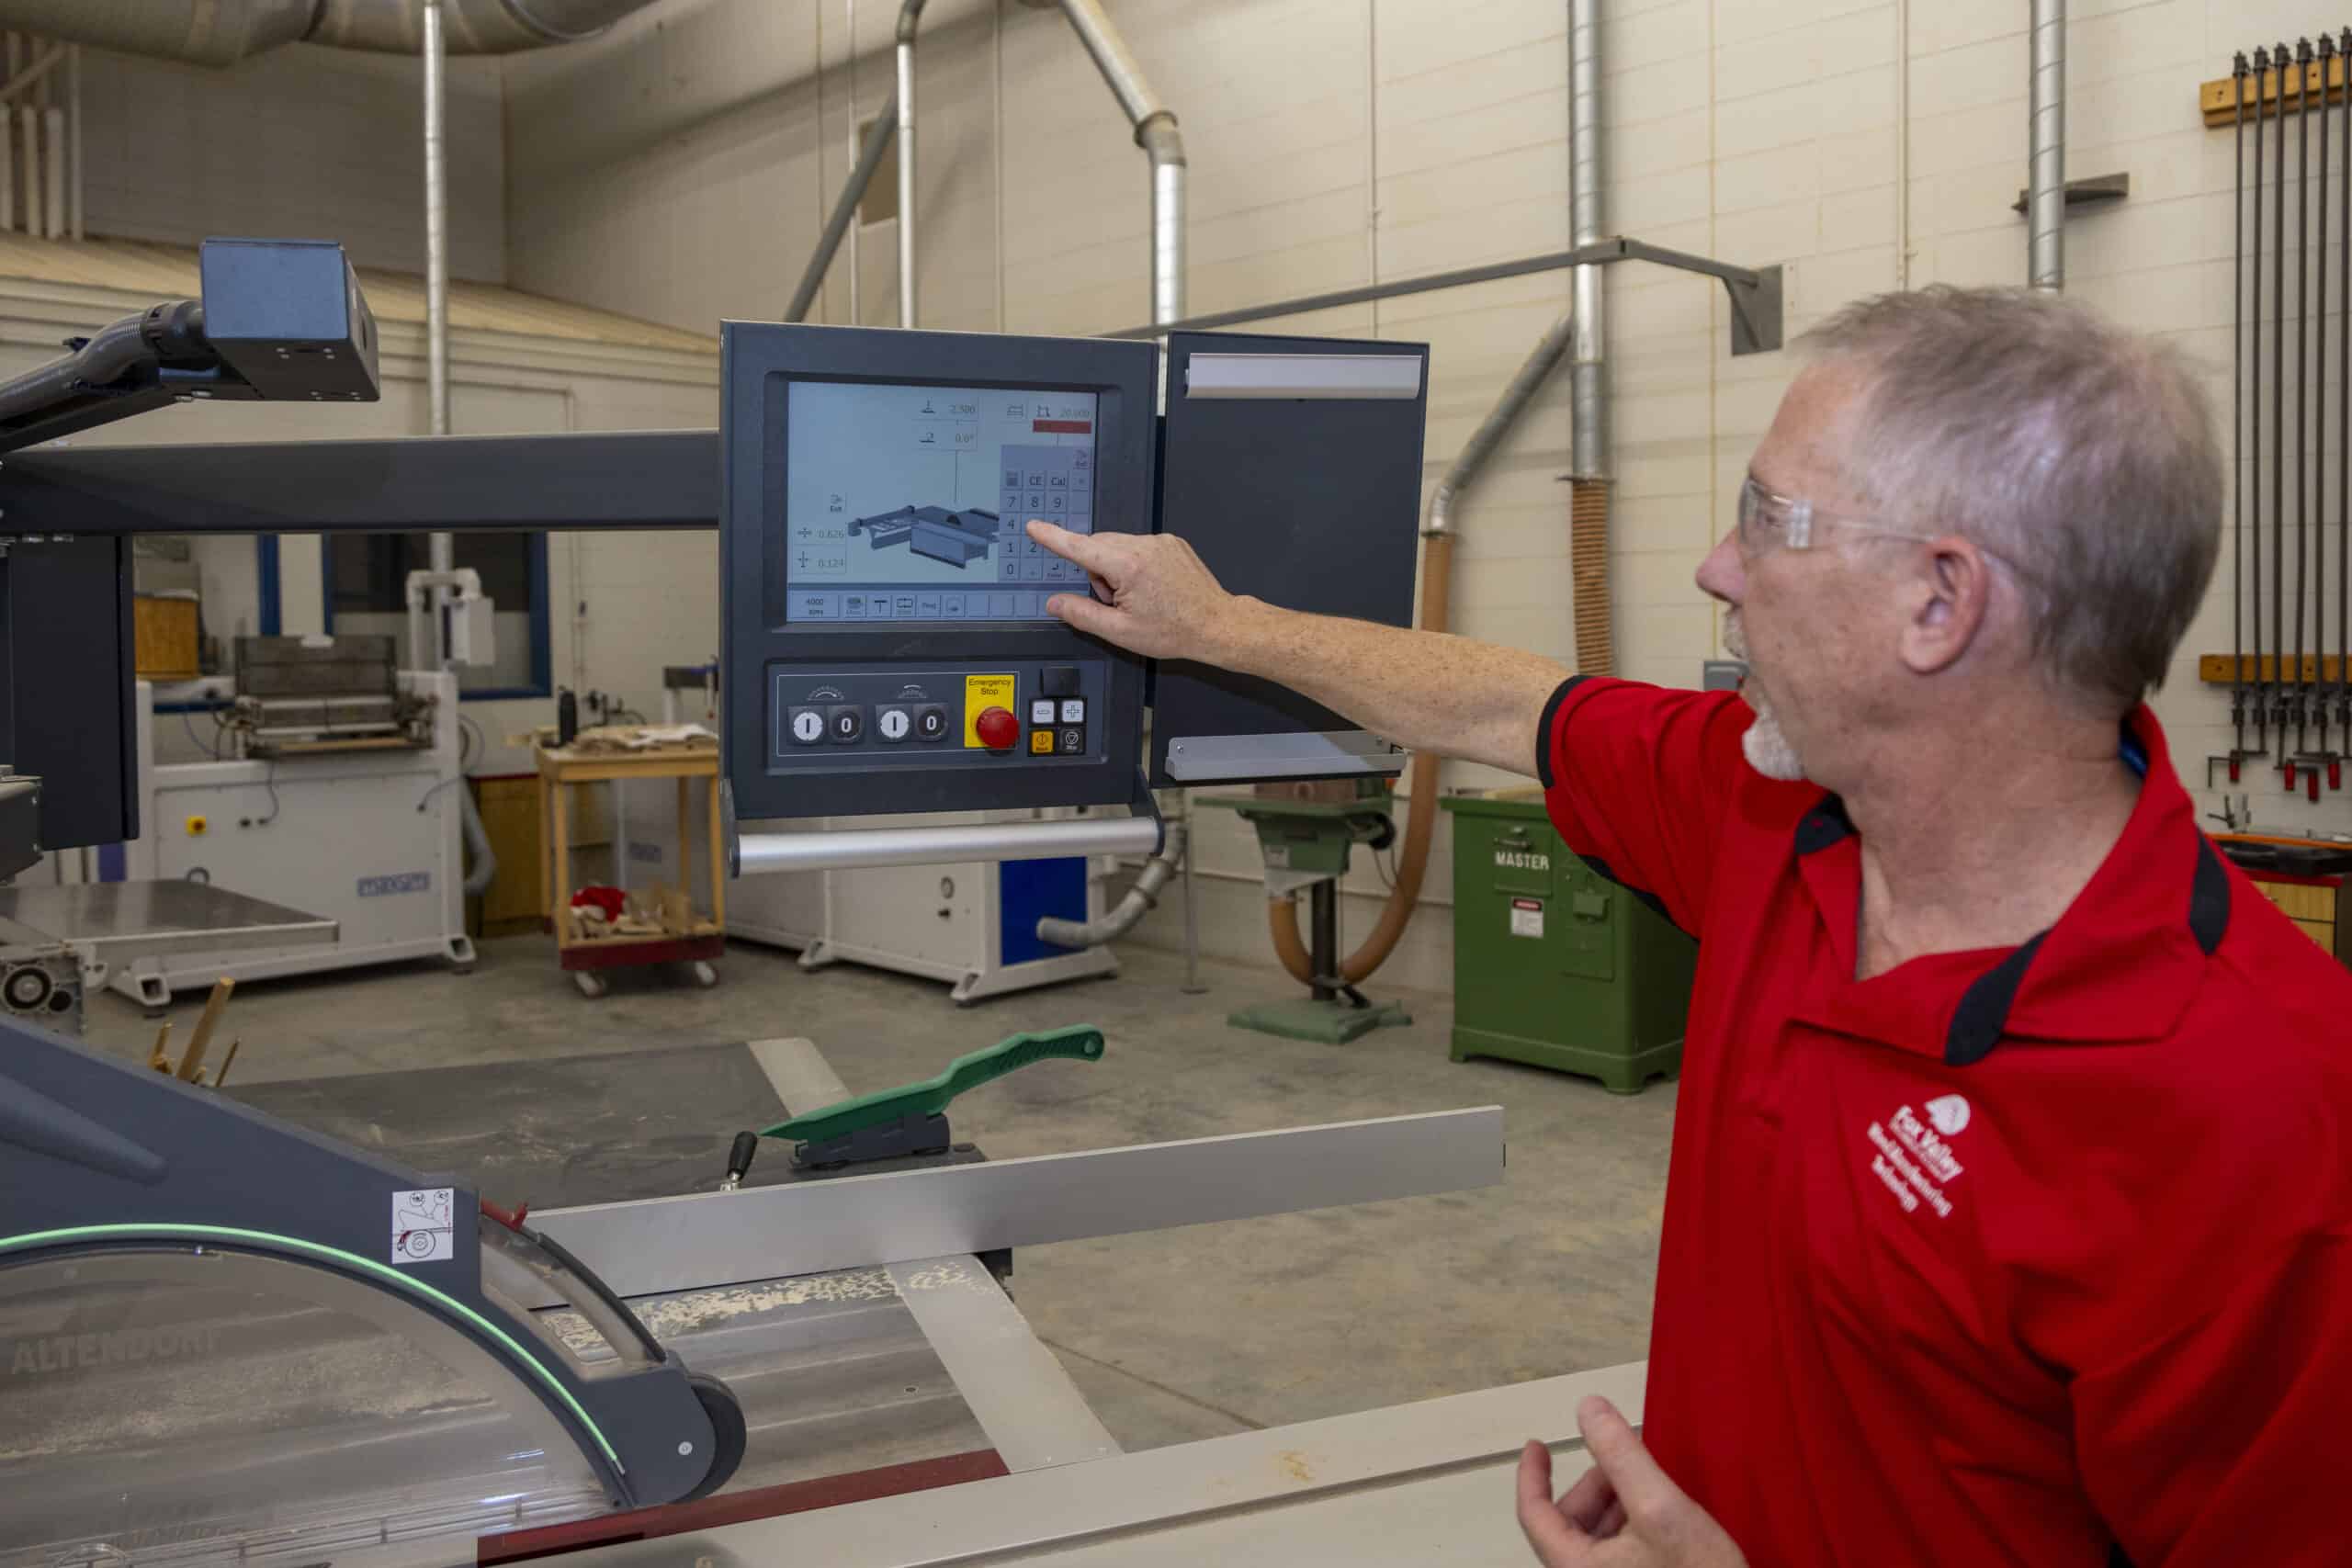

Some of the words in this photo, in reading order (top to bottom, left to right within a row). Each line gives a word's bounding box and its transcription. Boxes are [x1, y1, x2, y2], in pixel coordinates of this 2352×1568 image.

[1007, 497, 1016, 507] 7
[1030, 497, 1039, 507] 8
[1053, 498, 1062, 507] 9
[1007, 519, 1015, 530] 4
[968, 678, 1012, 688] Emergency
[980, 687, 999, 697] Stop
[1496, 852, 1549, 870] MASTER
